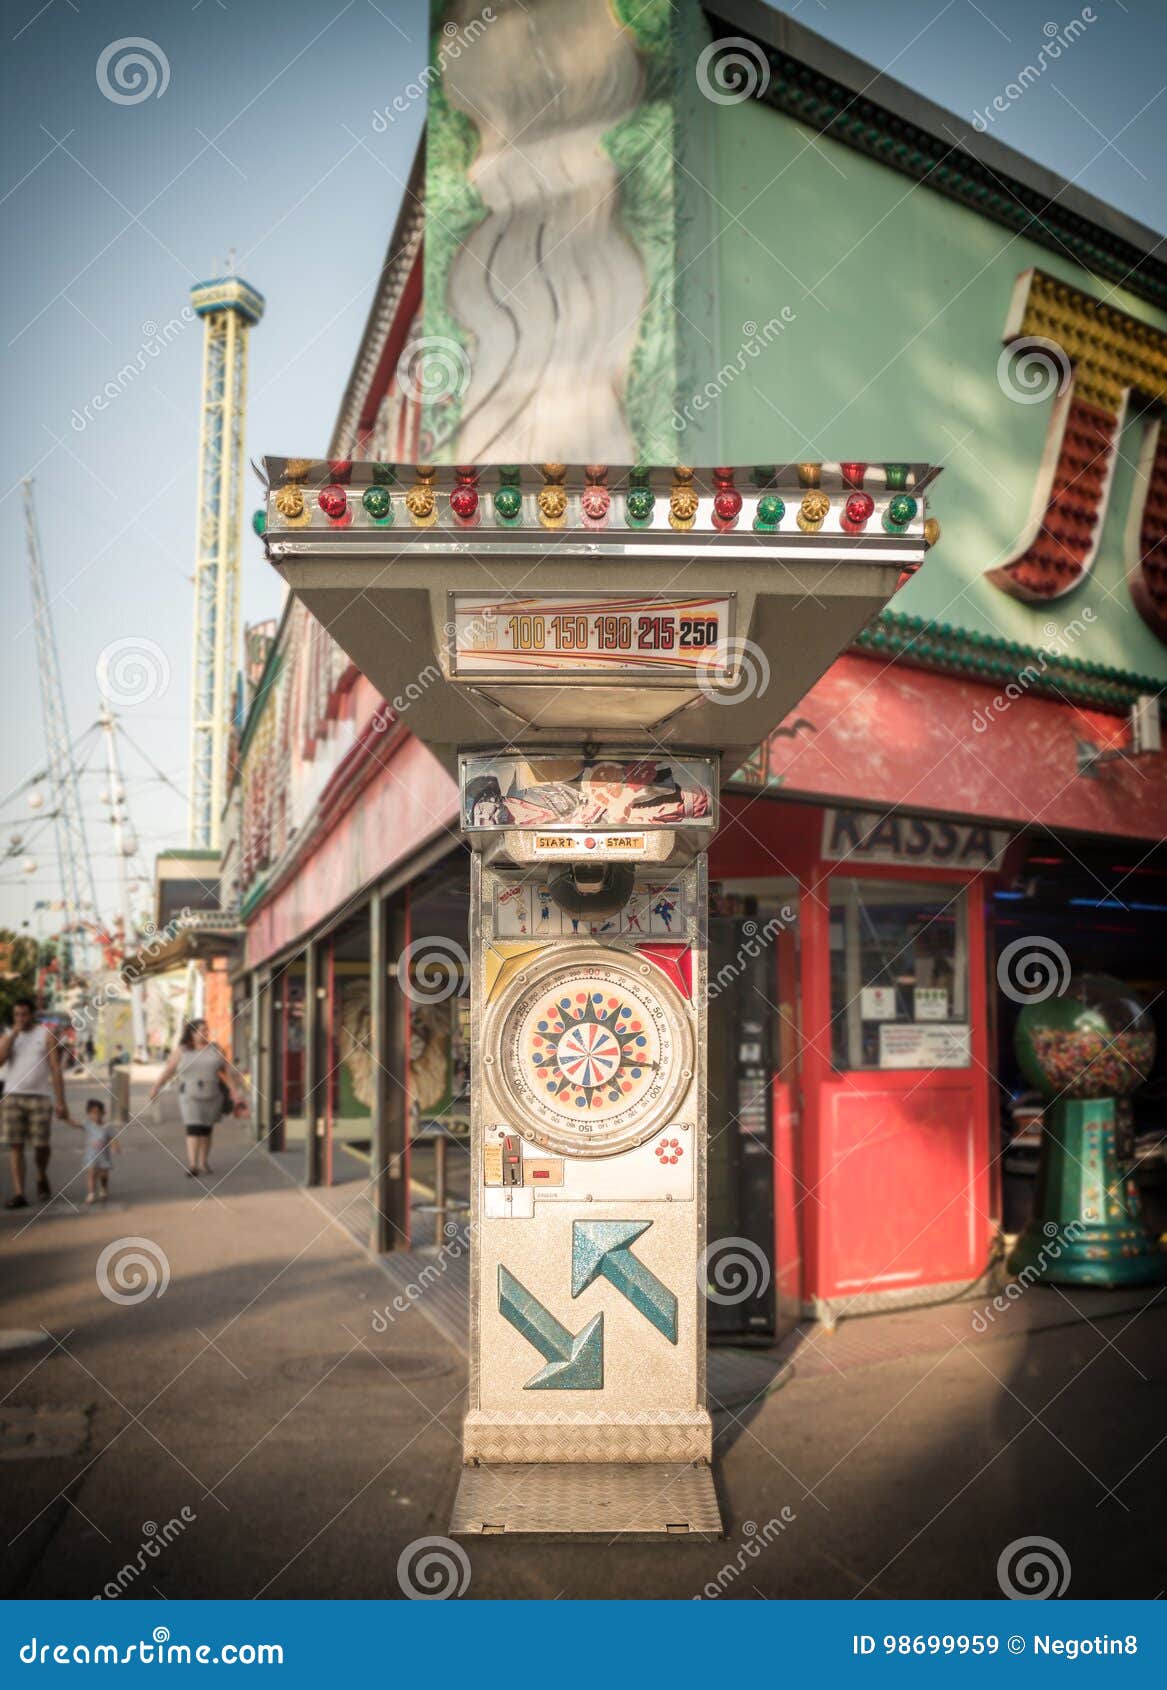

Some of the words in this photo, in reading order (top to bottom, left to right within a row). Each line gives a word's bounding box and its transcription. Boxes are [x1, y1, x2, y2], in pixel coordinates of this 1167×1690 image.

[509, 616, 545, 649] 100
[551, 616, 588, 649] 150
[594, 616, 632, 649] 190
[638, 616, 675, 650] 215
[679, 621, 718, 646] 250
[539, 838, 573, 847] START
[607, 837, 640, 847] START
[830, 808, 997, 863] KASSA
[516, 1001, 529, 1018] 250
[653, 1006, 664, 1020] 50
[512, 1079, 527, 1095] 200
[649, 1085, 662, 1100] 100
[578, 1124, 594, 1133] 150
